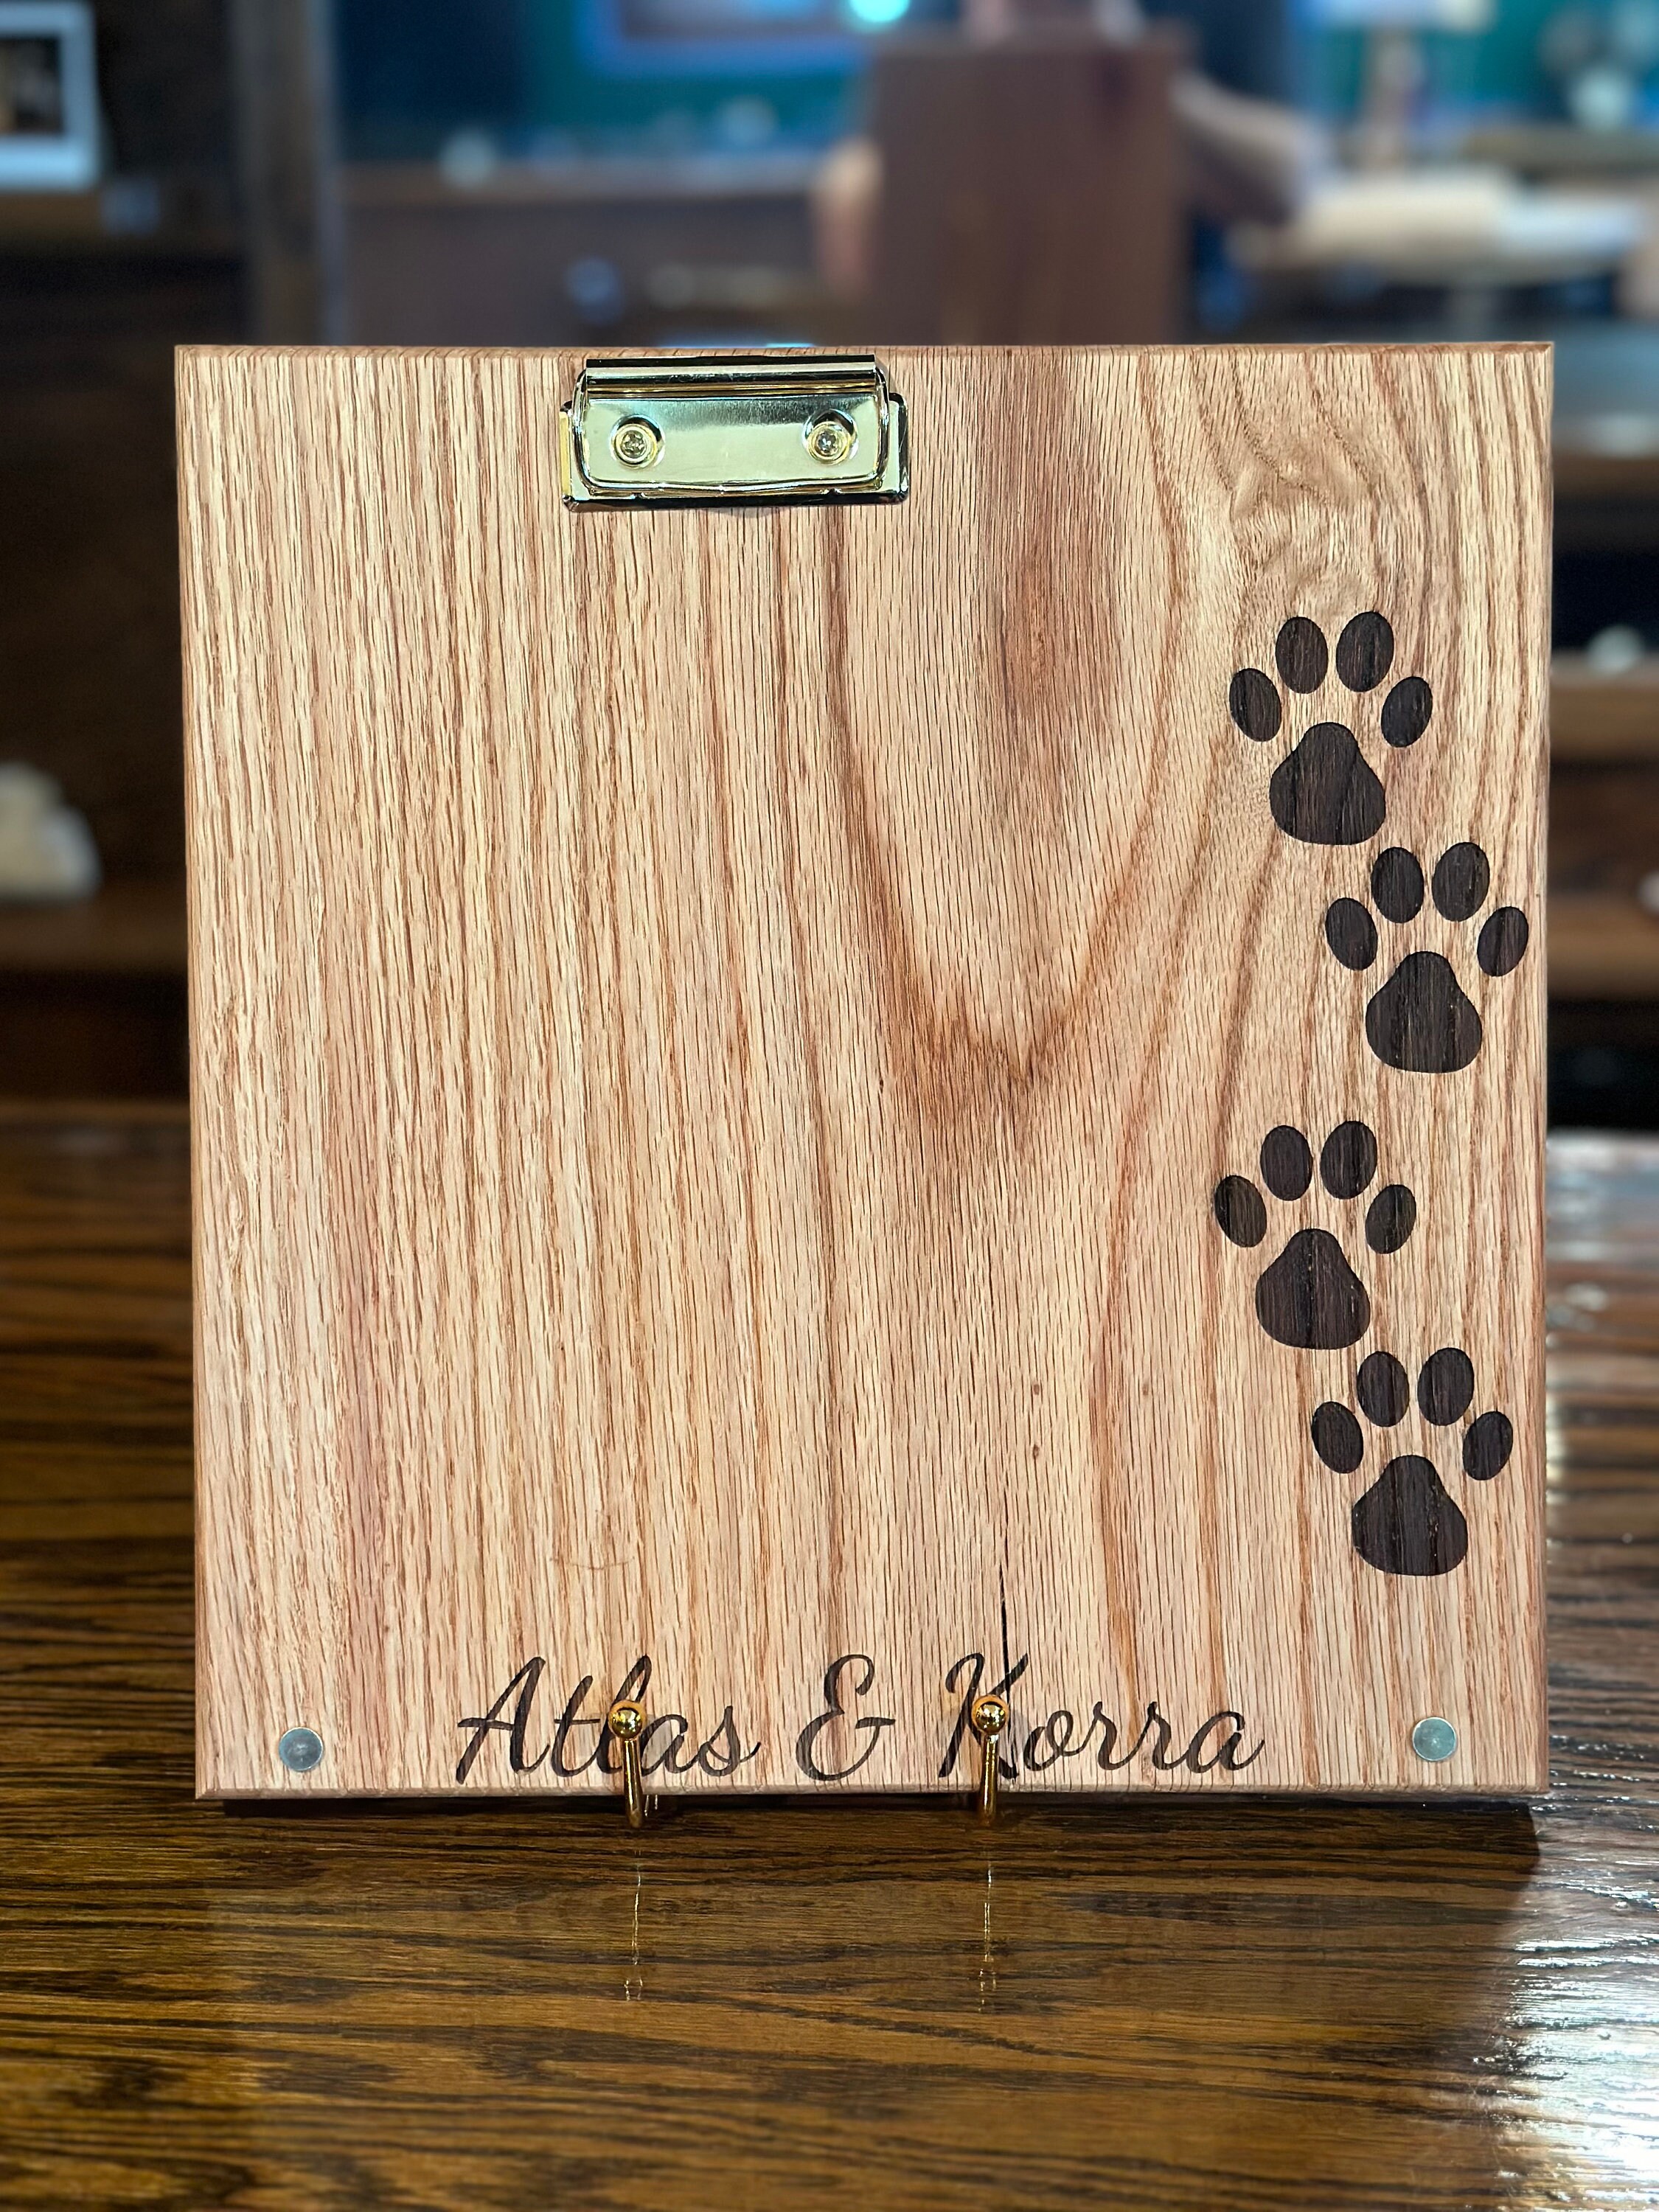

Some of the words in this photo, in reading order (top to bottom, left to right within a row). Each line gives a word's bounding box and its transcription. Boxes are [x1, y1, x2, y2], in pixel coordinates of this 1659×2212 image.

[456, 1654, 761, 1784] Atlas
[796, 1653, 895, 1781] &
[938, 1652, 1265, 1780] Korra
